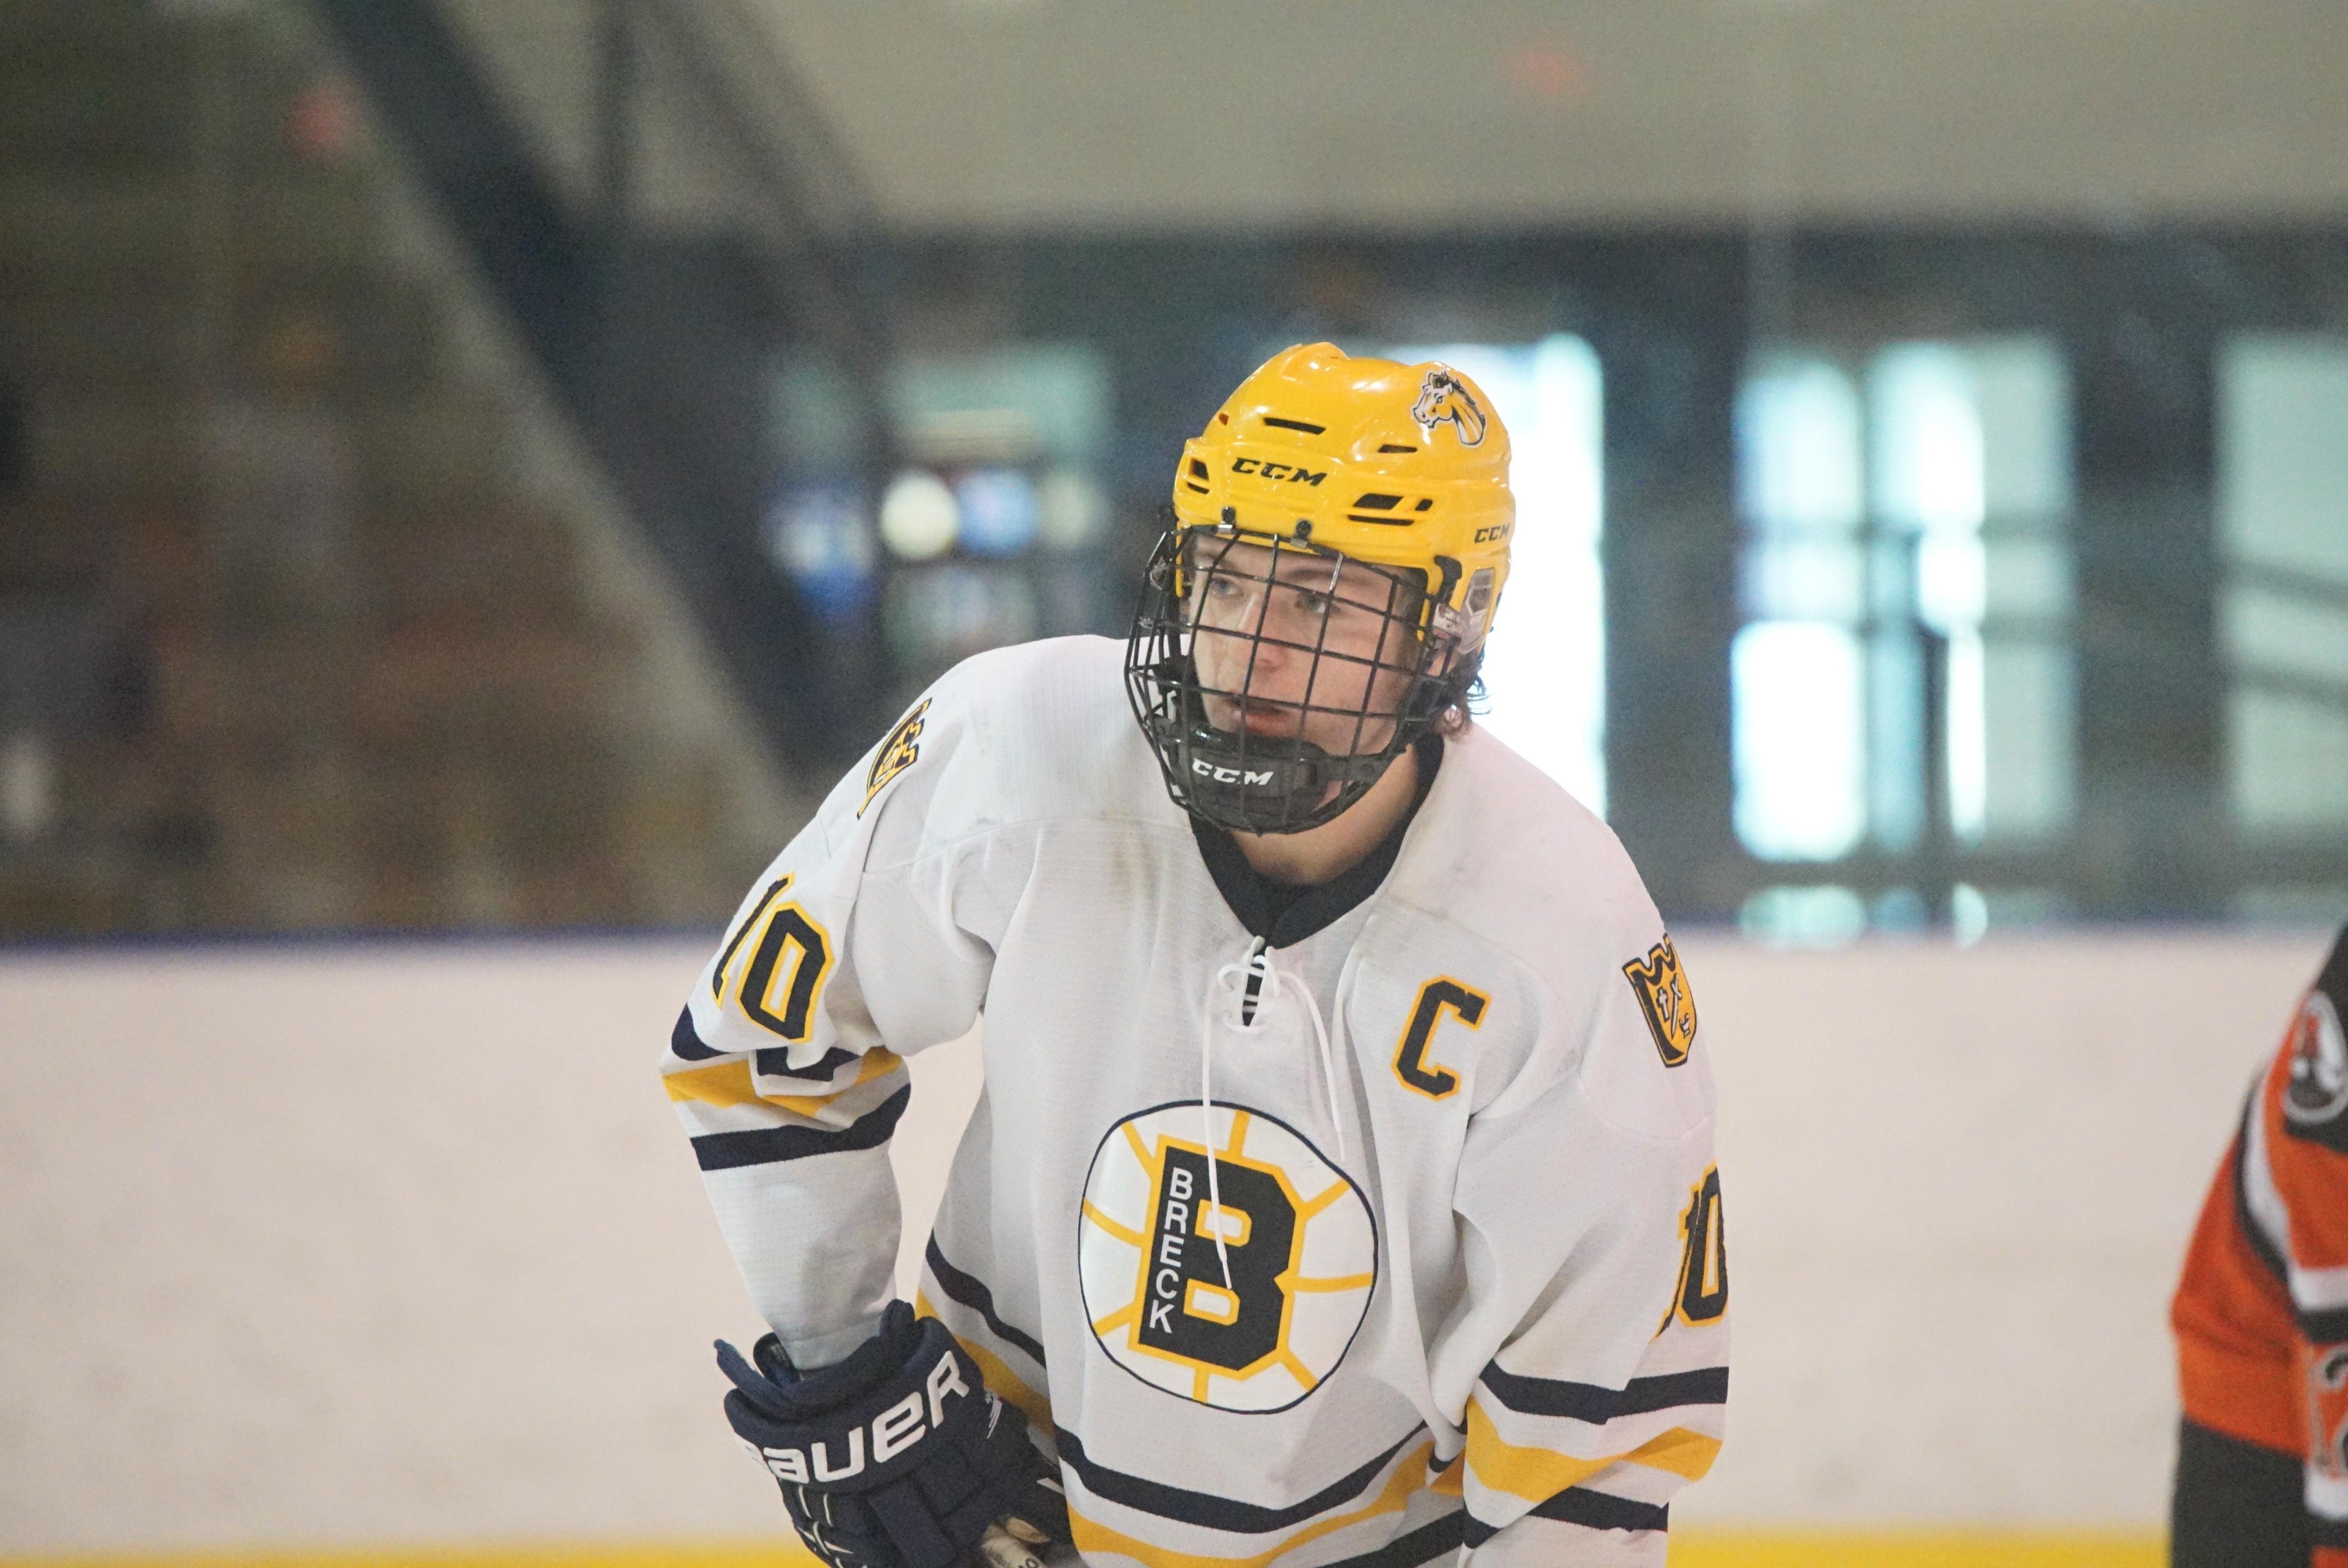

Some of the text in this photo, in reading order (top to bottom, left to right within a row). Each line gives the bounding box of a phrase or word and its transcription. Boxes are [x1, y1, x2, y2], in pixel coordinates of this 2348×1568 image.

[1231, 457, 1328, 486] CCM
[1474, 523, 1510, 544] CCM
[1192, 757, 1274, 785] CCM
[712, 871, 835, 1043] 10
[1391, 974, 1492, 1101] C
[1127, 1133, 1307, 1381] B
[1149, 1166, 1193, 1334] BRECK
